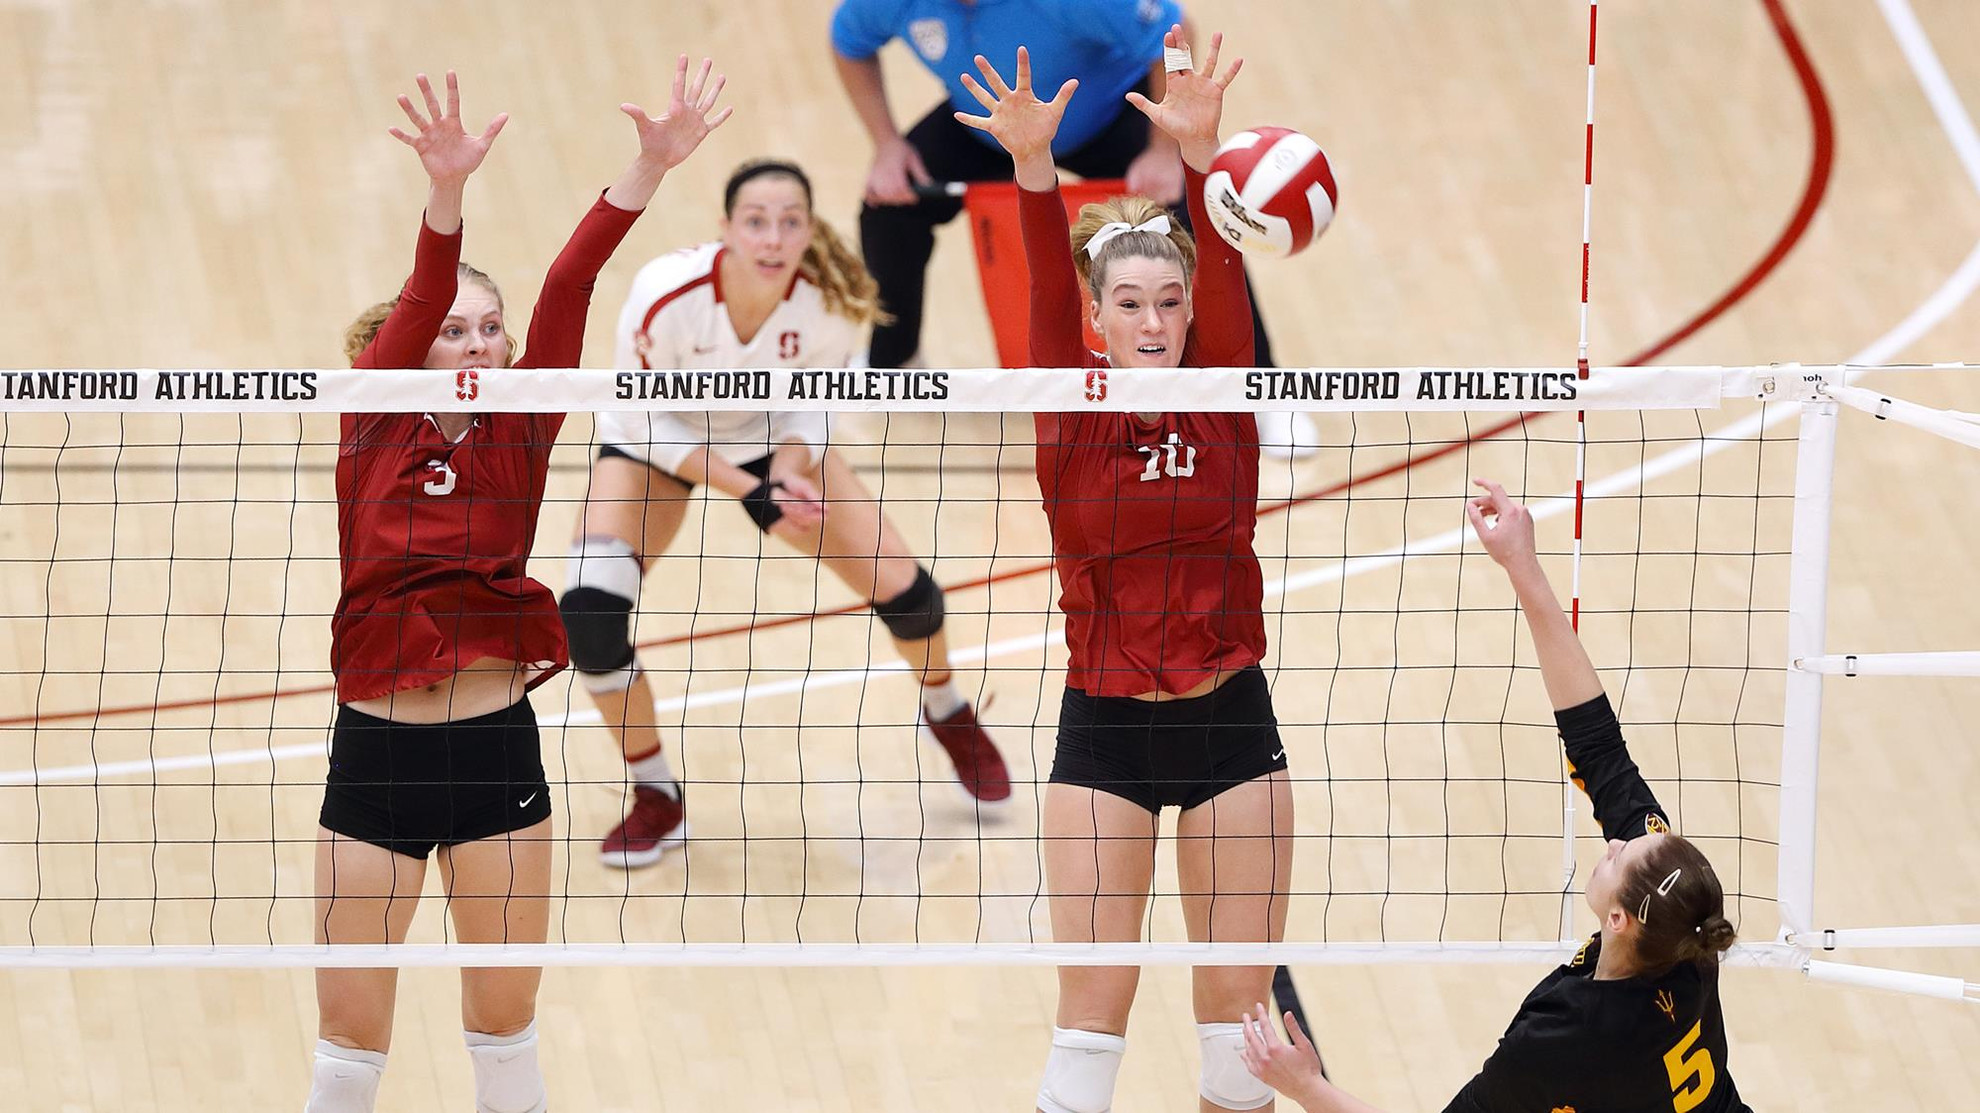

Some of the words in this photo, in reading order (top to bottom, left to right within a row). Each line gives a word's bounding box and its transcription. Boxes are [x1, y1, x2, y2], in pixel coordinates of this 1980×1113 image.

[155, 371, 317, 400] ATHLETICS
[616, 371, 771, 400] STANFORD
[788, 371, 949, 400] ATHLETICS
[1246, 371, 1400, 400] STANFORD
[1416, 371, 1577, 400] ATHLETICS
[1137, 432, 1197, 482] 10
[424, 459, 457, 496] 3
[1663, 1019, 1716, 1113] 5
